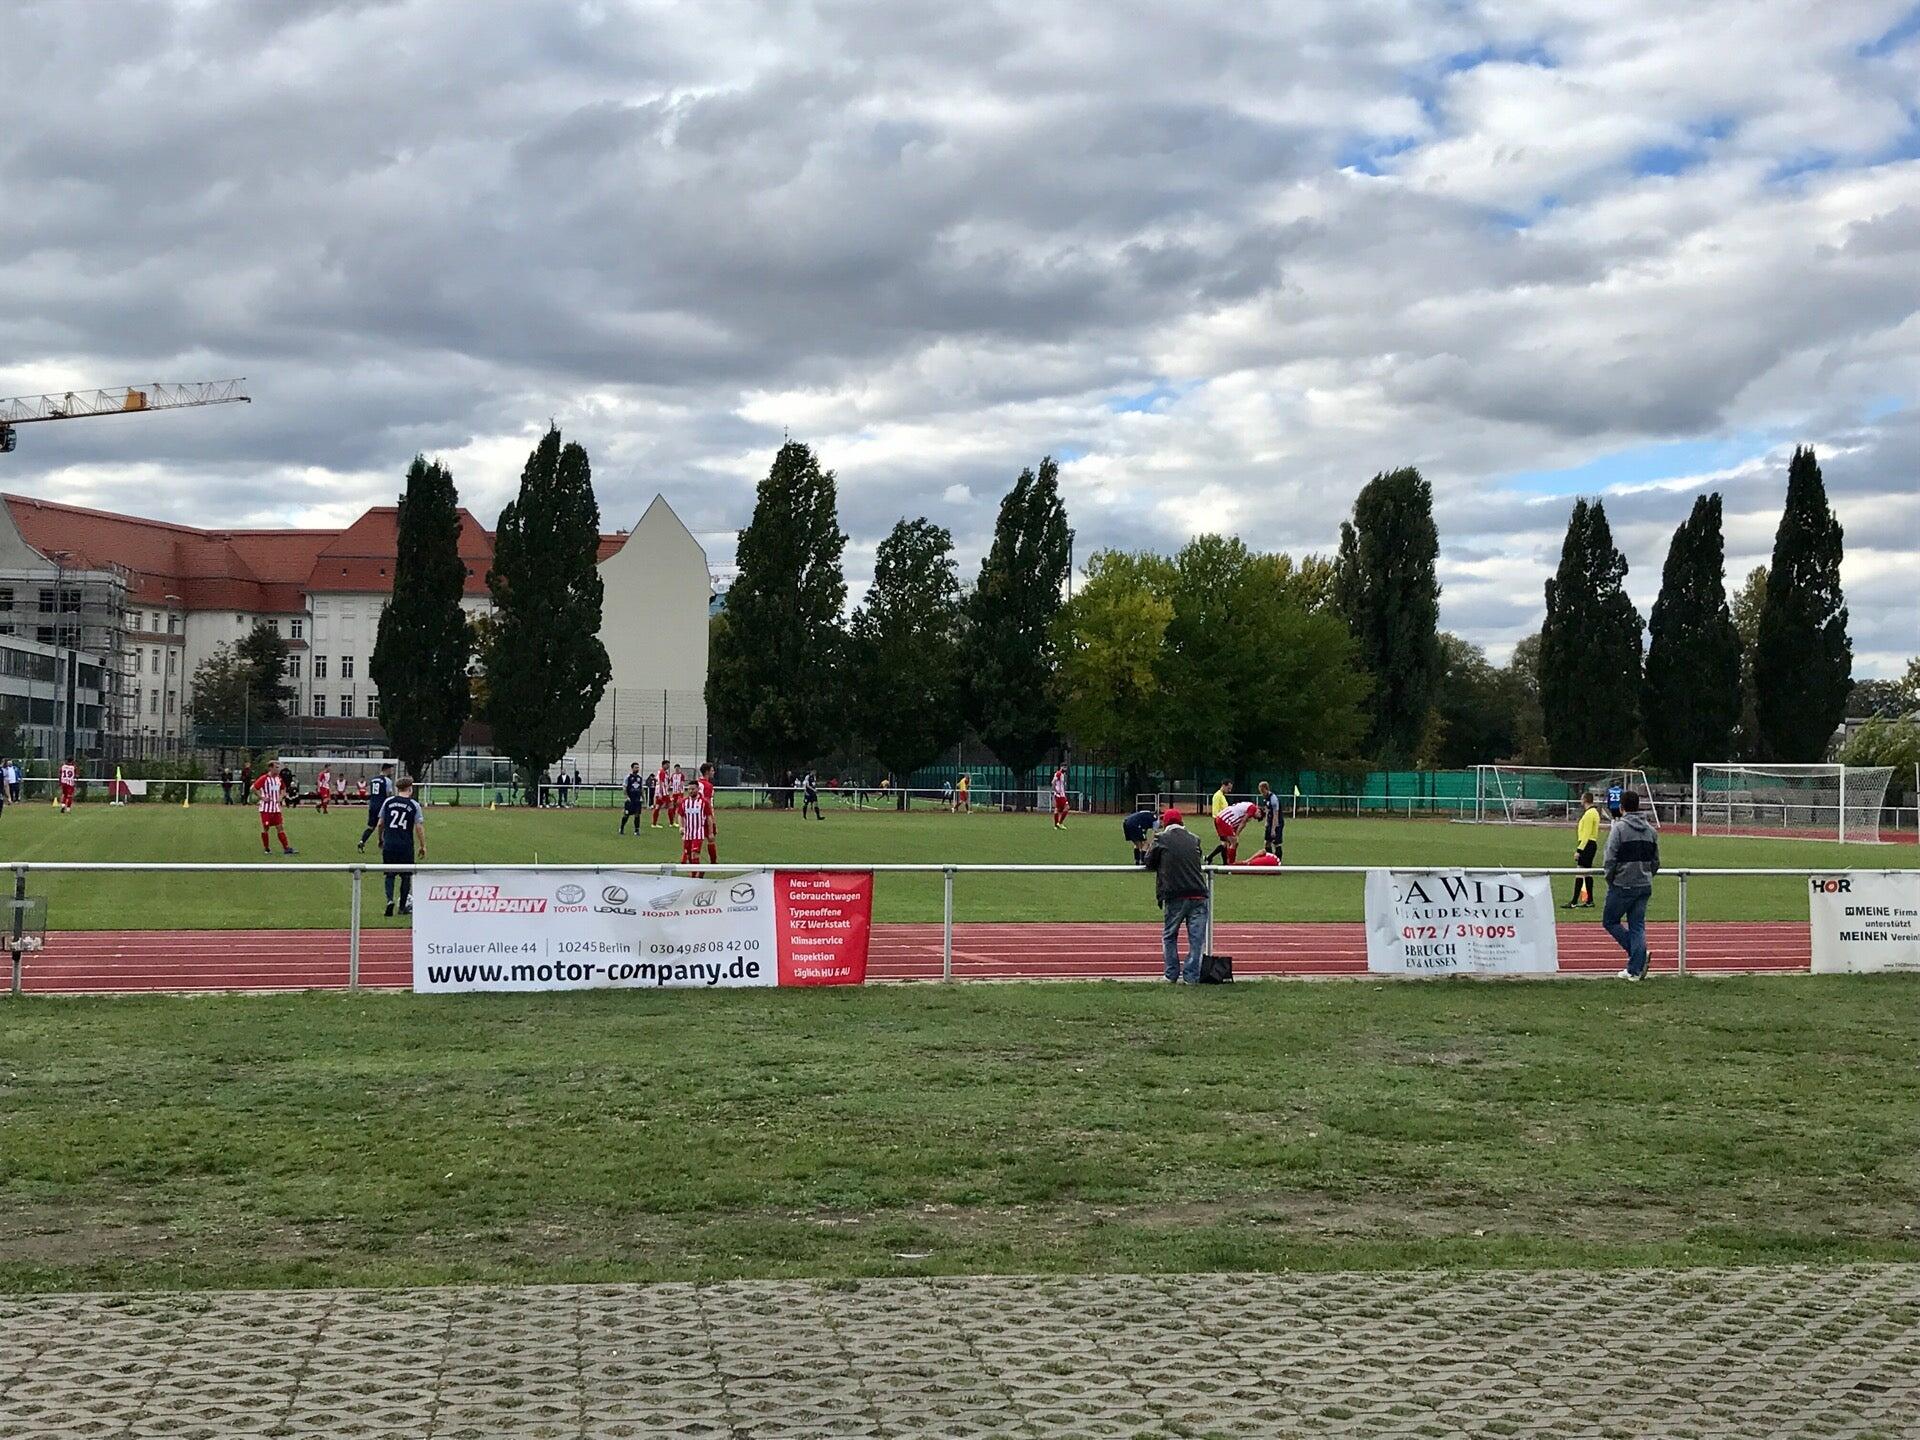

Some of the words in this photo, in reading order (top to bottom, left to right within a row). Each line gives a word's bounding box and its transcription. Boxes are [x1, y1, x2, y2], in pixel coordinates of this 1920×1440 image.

[62, 770, 73, 778] 19
[389, 810, 407, 829] 24
[789, 879, 812, 888] Neu-
[813, 879, 831, 888] und
[431, 886, 496, 900] MOTOR
[1392, 876, 1525, 904] AWID
[789, 891, 861, 902] Gebrauchtwagen
[456, 899, 545, 913] COMPANY
[554, 905, 589, 913] TOYOTA
[593, 905, 637, 916] LEXUS
[685, 907, 723, 916] HONDA
[1855, 906, 1890, 917] MEINE
[1893, 908, 1918, 917] Firma
[641, 910, 681, 918] HONDA
[789, 907, 842, 918] Typenoffene
[790, 920, 807, 929] KFZ
[807, 920, 851, 929] Werkstatt
[1865, 920, 1912, 928] unterstützt
[790, 936, 844, 945] Klimaservice
[1839, 931, 1888, 941] MEINEN
[427, 942, 485, 954] Stralauer
[487, 942, 519, 953] Allee
[520, 942, 537, 952] 44
[558, 941, 597, 953] 10245
[599, 941, 631, 953] Berlin
[650, 944, 674, 954] 030
[792, 953, 835, 962] Inspektion
[427, 956, 760, 986] www.motor-company.de
[794, 968, 820, 979] täglich
[821, 968, 834, 977] HU
[834, 968, 841, 976] &
[840, 967, 851, 976] AU
